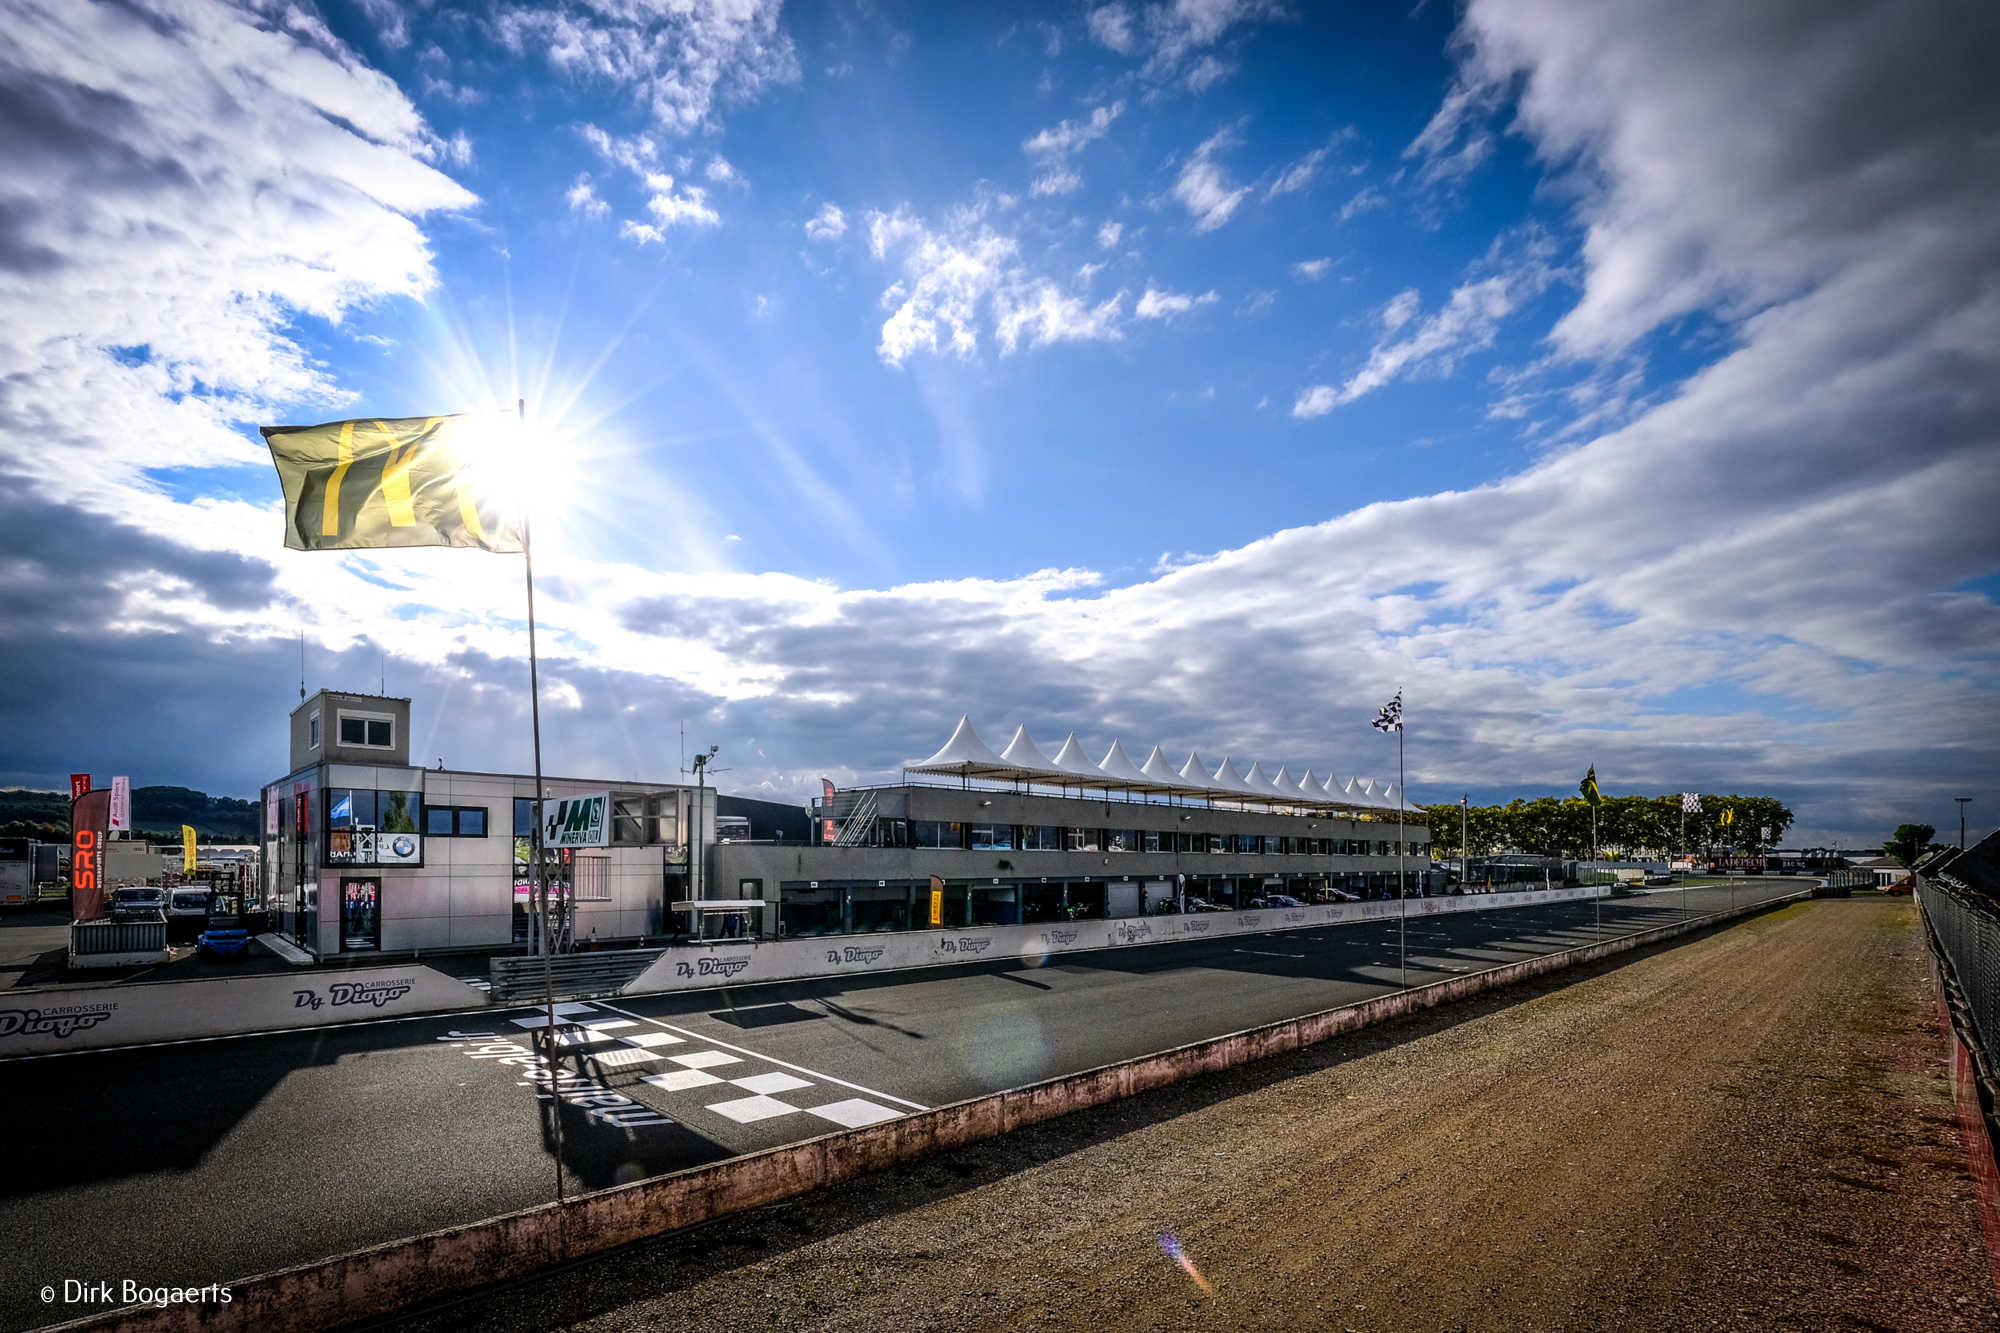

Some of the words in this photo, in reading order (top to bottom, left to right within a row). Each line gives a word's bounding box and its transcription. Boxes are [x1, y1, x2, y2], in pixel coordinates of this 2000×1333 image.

[560, 830, 587, 844] MINERVA
[74, 831, 94, 888] SRO
[844, 947, 883, 964] Diogo
[698, 957, 748, 977] Diogo
[365, 977, 416, 989] CARROSSERIE
[329, 983, 411, 1007] Diogo
[42, 1002, 120, 1016] CARROSSERIE
